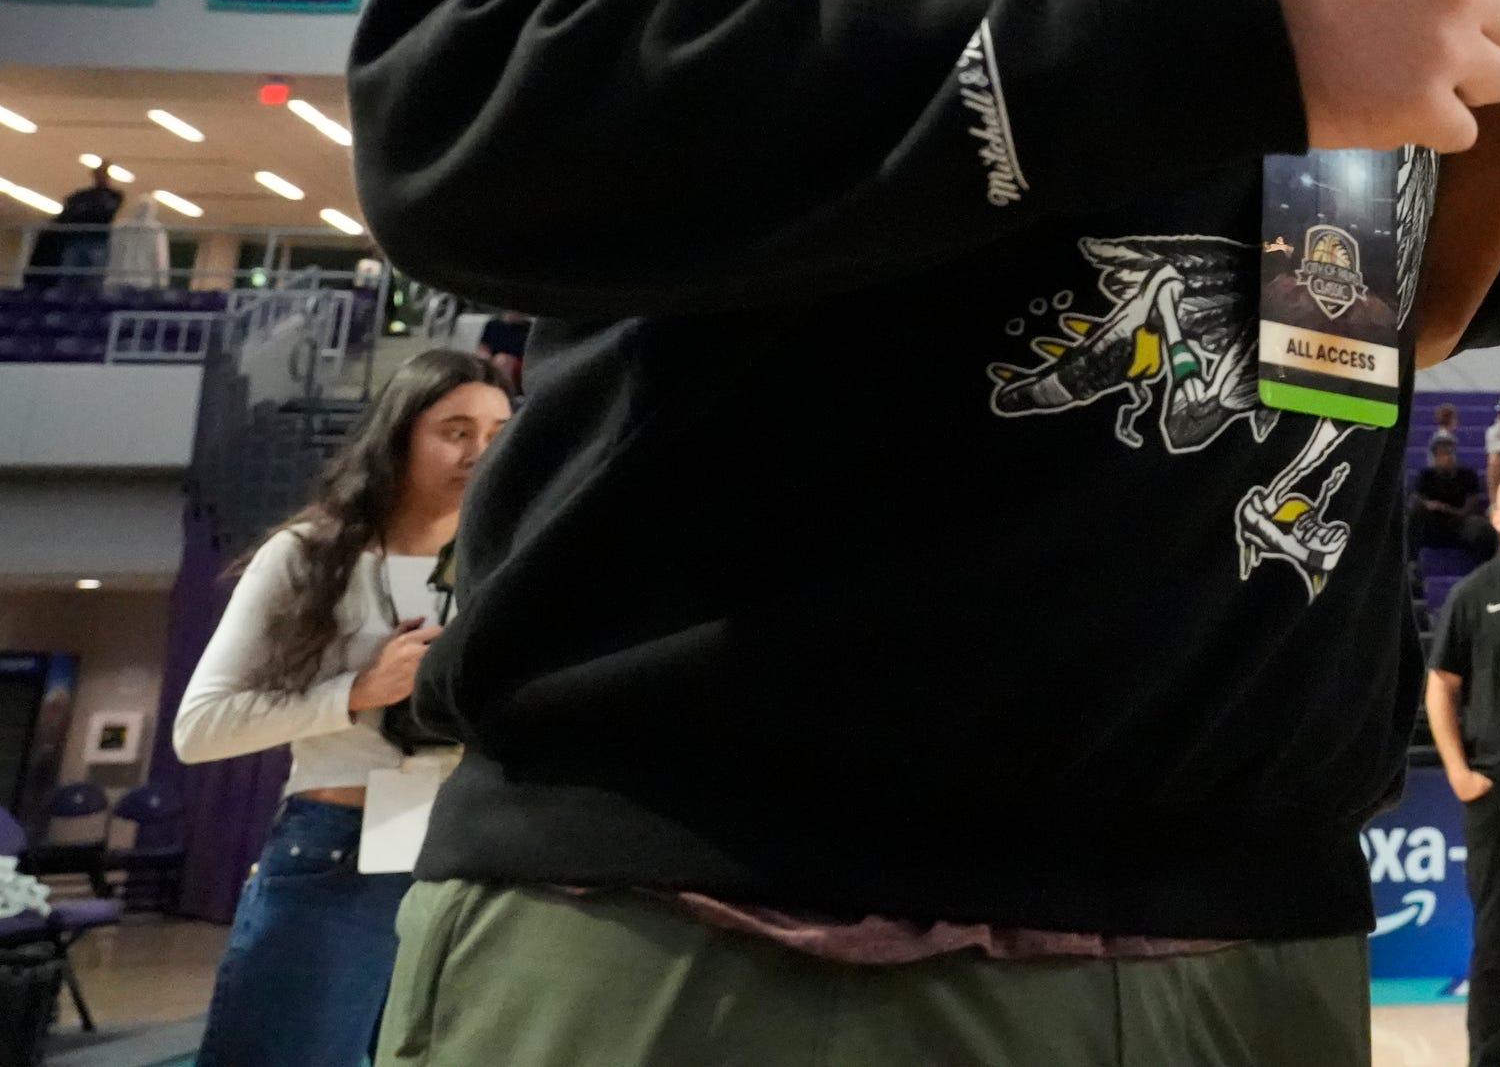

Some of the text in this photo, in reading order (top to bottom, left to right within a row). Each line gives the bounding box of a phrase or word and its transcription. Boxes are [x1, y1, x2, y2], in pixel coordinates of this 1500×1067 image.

[959, 87, 1022, 206] Mitchell
[1286, 338, 1376, 372] ALL ACCESS
